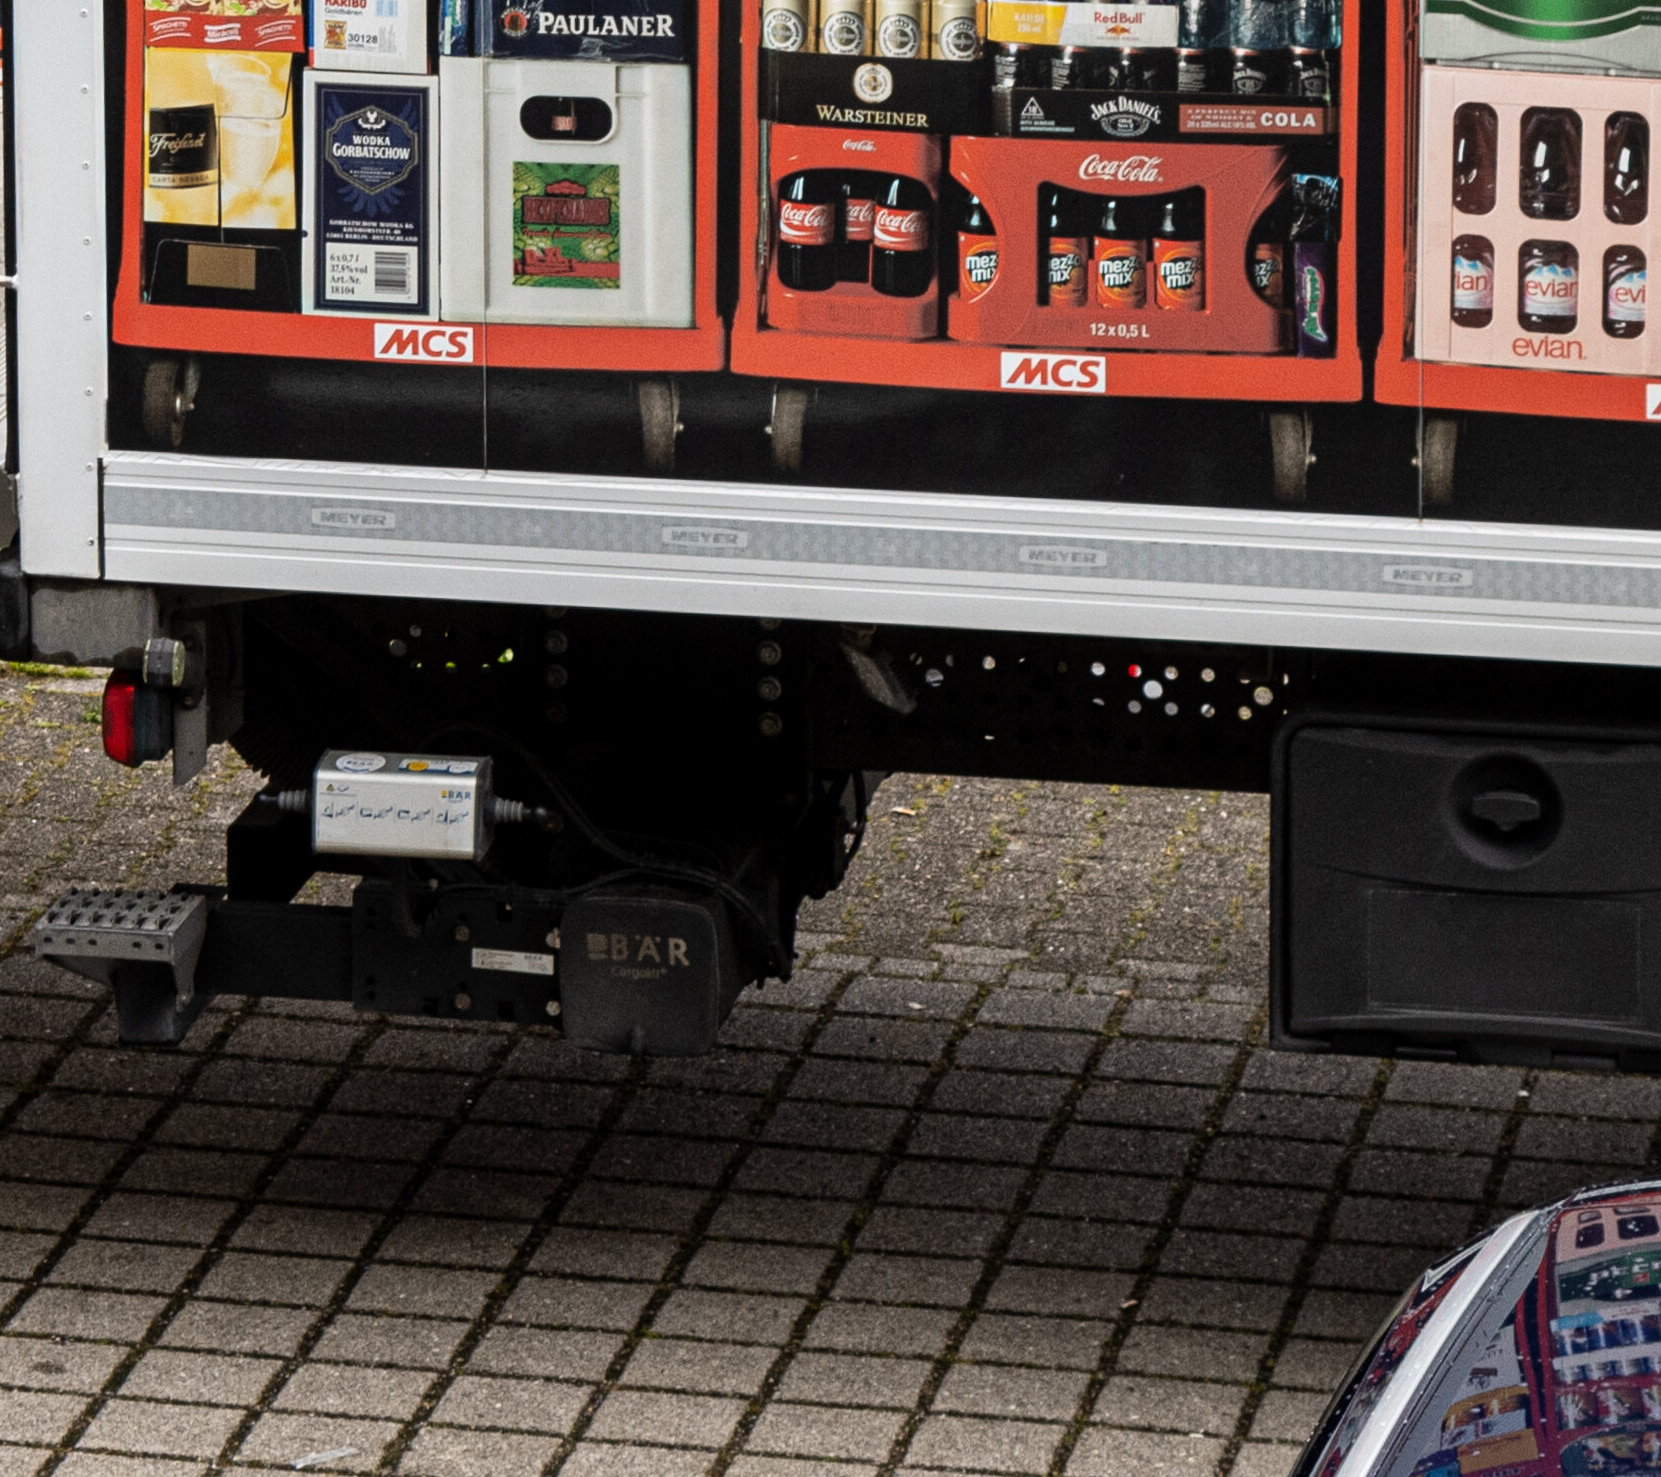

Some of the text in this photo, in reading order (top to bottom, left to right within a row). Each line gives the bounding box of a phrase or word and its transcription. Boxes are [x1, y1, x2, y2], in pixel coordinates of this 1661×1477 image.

[538, 11, 674, 37] PAULANER
[1094, 11, 1143, 25] Red Bull
[348, 34, 378, 44] 30128
[815, 103, 929, 130] WARSTEINER
[1260, 111, 1316, 128] COLA
[353, 135, 391, 146] WODKA
[332, 141, 411, 160] GORBATSCHOW
[1078, 153, 1161, 183] Coca-Cola
[331, 286, 355, 294] 18104
[1089, 323, 1105, 338] 12
[1117, 324, 1139, 339] 0,5
[1140, 325, 1150, 339] L
[379, 328, 469, 359] MCS
[1005, 358, 1101, 390] MCS
[318, 510, 388, 527] MEYER
[669, 529, 740, 545] MEYER
[1027, 549, 1098, 565] MEYER
[609, 933, 691, 967] BÄR
